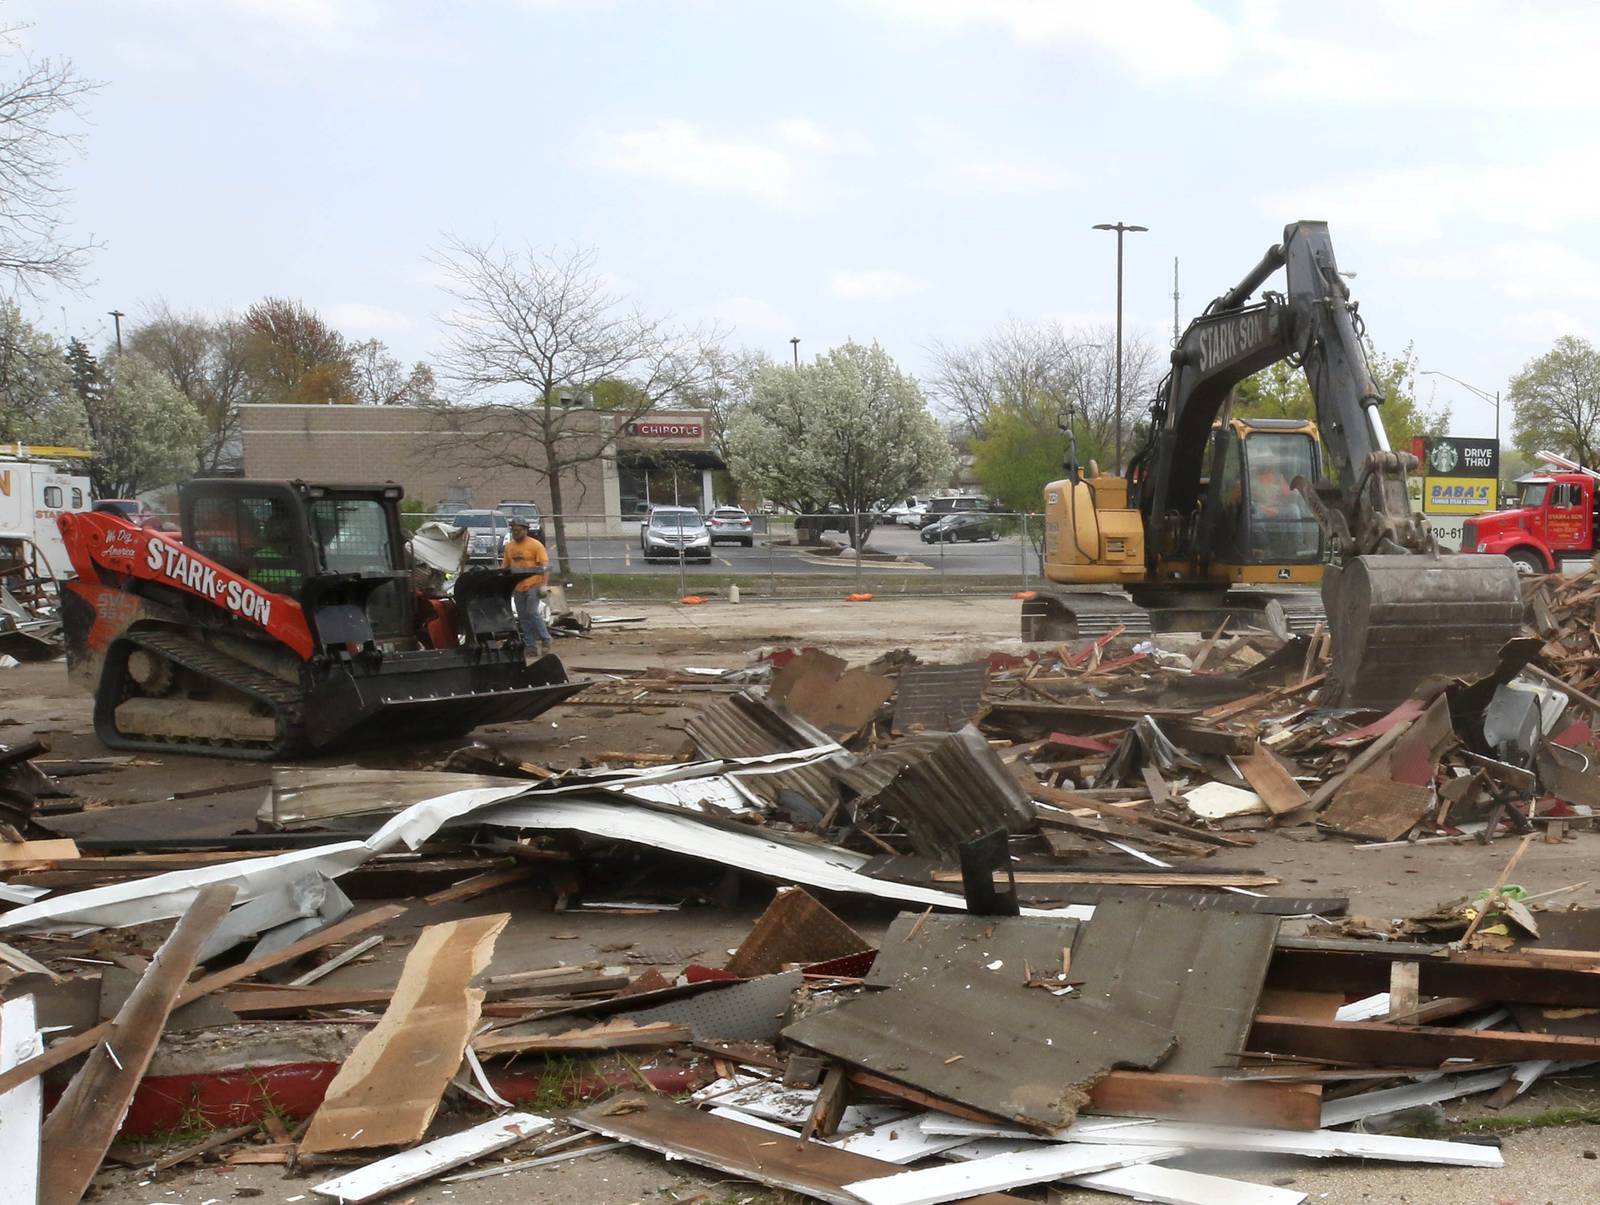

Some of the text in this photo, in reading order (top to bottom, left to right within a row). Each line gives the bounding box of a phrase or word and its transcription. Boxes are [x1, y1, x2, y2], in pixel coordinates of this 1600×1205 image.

[1200, 320, 1236, 371] STARK
[1240, 314, 1263, 350] SON
[642, 426, 699, 435] CHIPOTLE
[1464, 448, 1492, 457] DRIVE
[1464, 458, 1490, 467] THRU
[1432, 485, 1489, 497] BABA'S
[147, 538, 271, 625] STARK & SON
